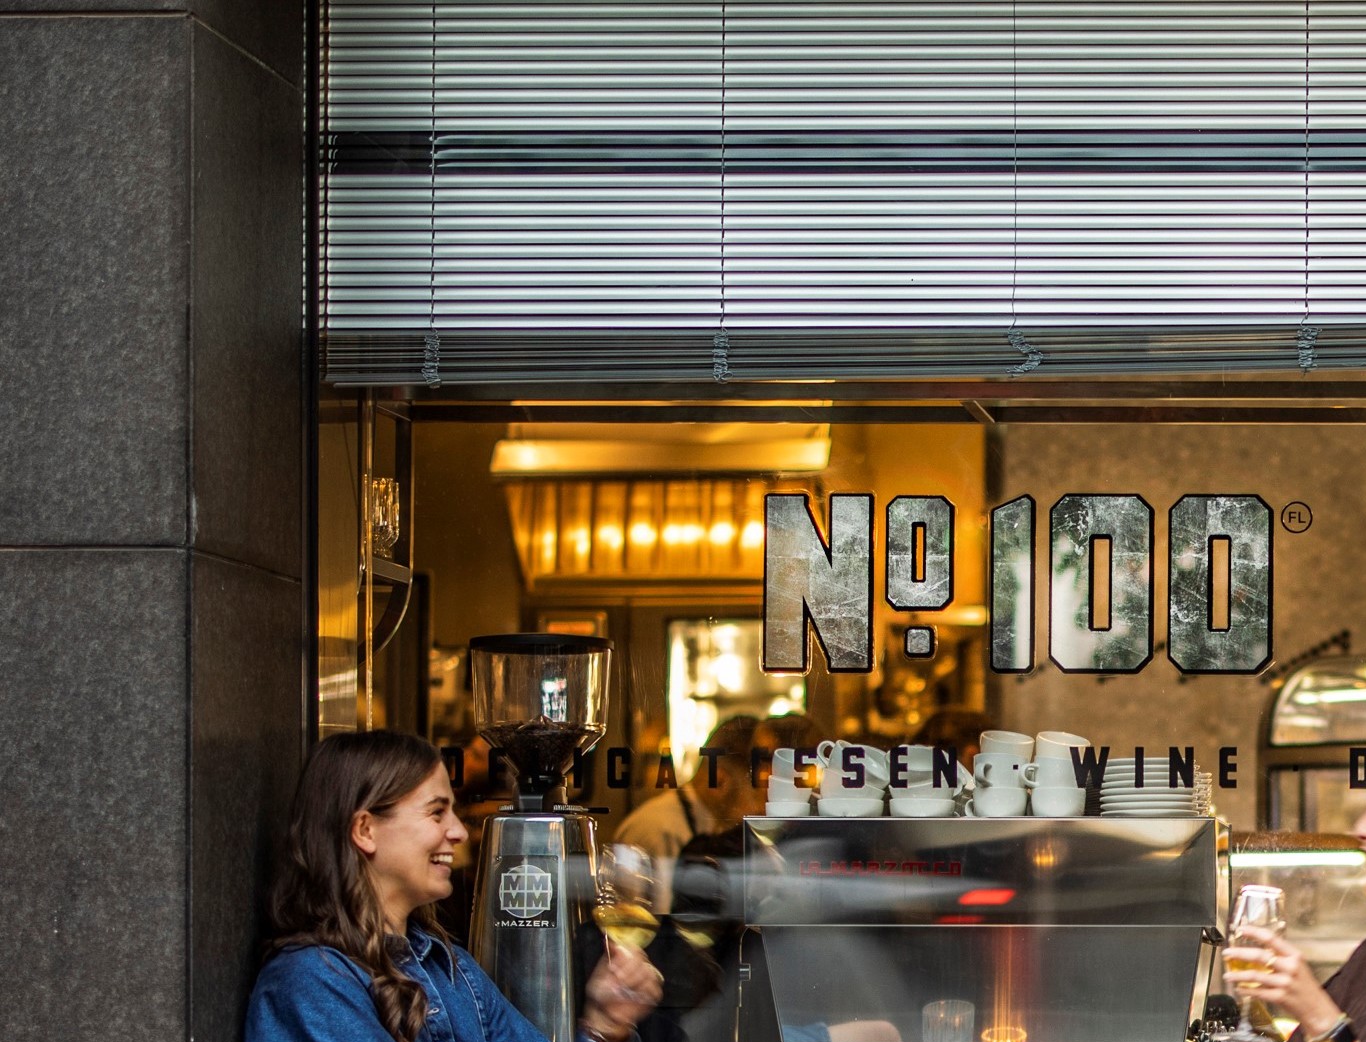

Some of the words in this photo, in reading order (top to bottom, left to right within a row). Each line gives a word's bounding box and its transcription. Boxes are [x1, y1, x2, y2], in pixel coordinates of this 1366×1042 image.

[1288, 511, 1306, 523] FL
[440, 747, 957, 789] DEICATESSEN
[1070, 746, 1237, 788] WINE
